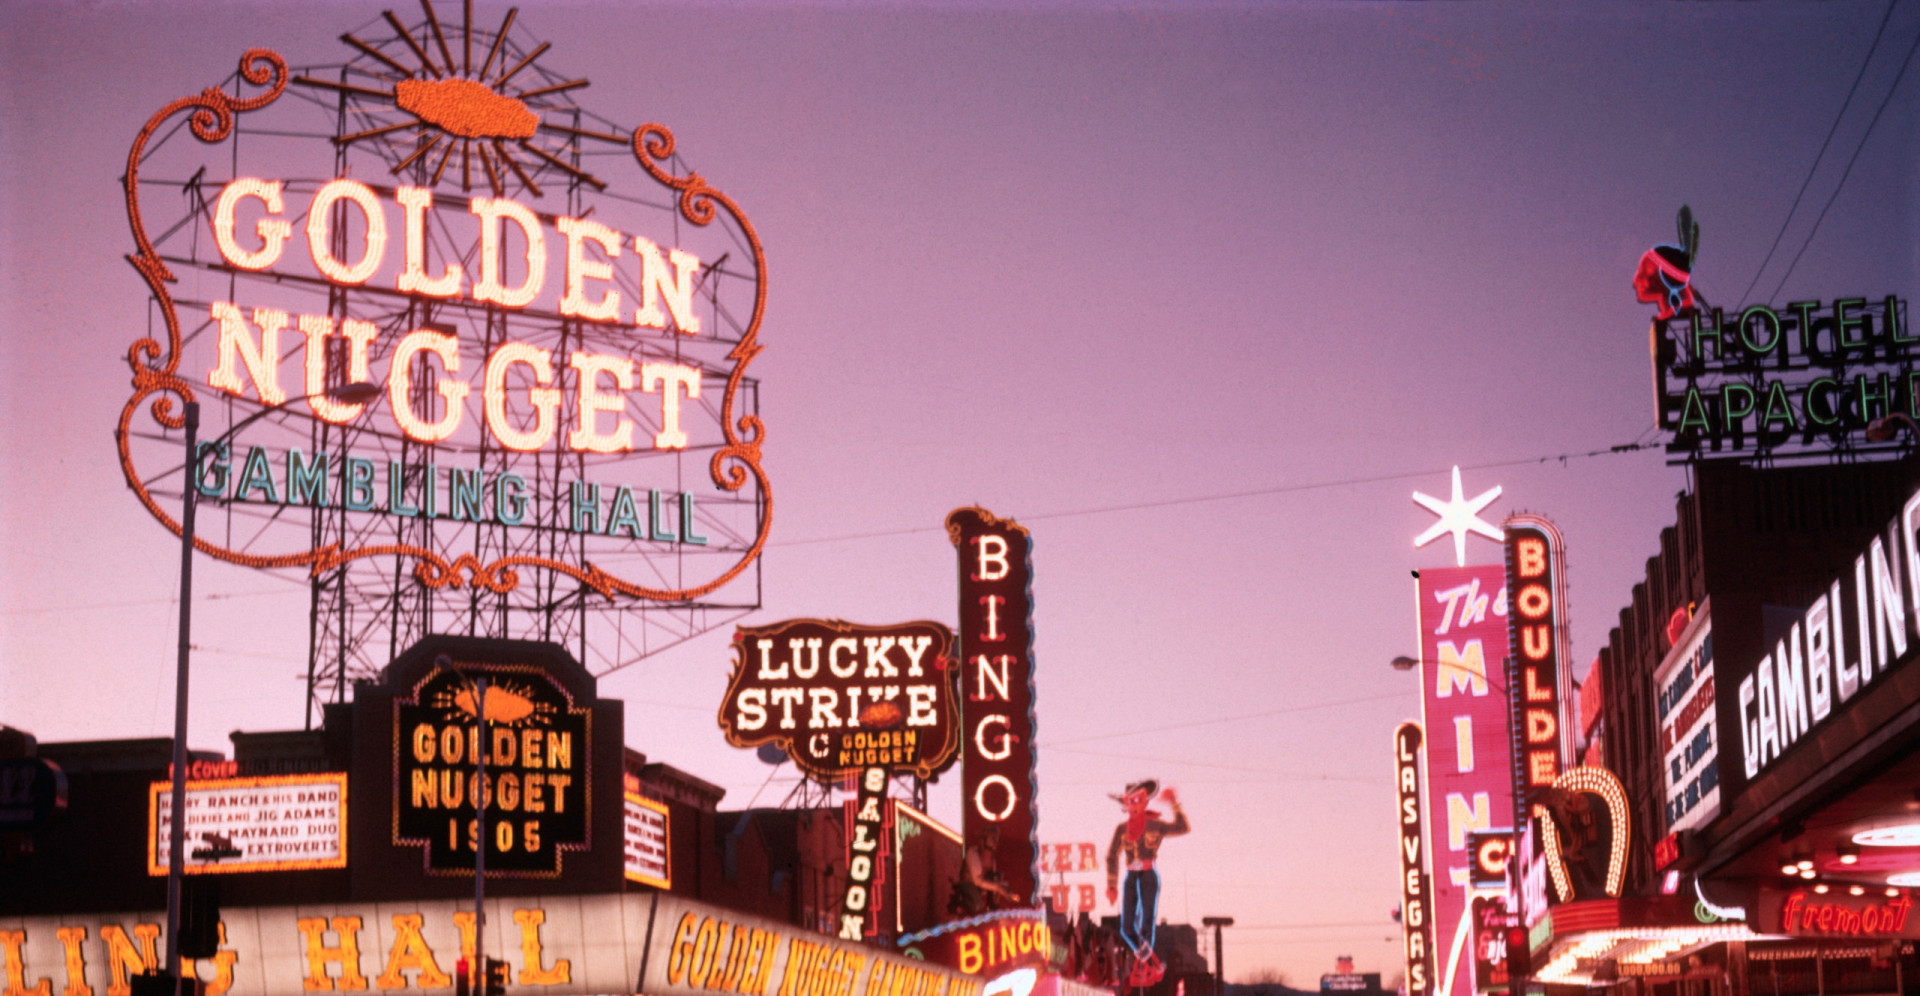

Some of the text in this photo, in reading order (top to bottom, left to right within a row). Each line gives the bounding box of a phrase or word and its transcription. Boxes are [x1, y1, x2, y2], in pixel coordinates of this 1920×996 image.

[213, 177, 701, 333] GOLDEN
[1692, 296, 1920, 358] HOTEL
[208, 301, 701, 453] NUGGET
[194, 441, 709, 544] GAMBLING HALL
[757, 636, 932, 680] LUCKY
[971, 535, 1019, 822] BINGO
[1518, 538, 1556, 817] BOULDE
[412, 723, 572, 769] GOLDEN
[839, 747, 915, 767] NUGGET
[842, 730, 916, 750] GOLDEN
[192, 760, 238, 779] COVER
[411, 768, 572, 814] NUGGET
[161, 798, 200, 809] HRY
[208, 795, 259, 808] RANCH
[273, 793, 293, 804] HIS
[297, 791, 338, 804] BAND
[255, 810, 278, 822] JIG
[283, 807, 336, 820] ADAMS
[228, 826, 299, 838] MAYNARD
[307, 824, 337, 836] DUO
[247, 840, 338, 855] EXTROVERTS
[449, 818, 541, 853] 1905
[839, 767, 885, 942] SALOON
[1400, 734, 1427, 991] LAS VEGAS
[297, 909, 571, 990] HALL
[668, 911, 781, 996] GOLDEN
[779, 937, 867, 996] NUGGET
[959, 921, 1045, 974] BINGO
